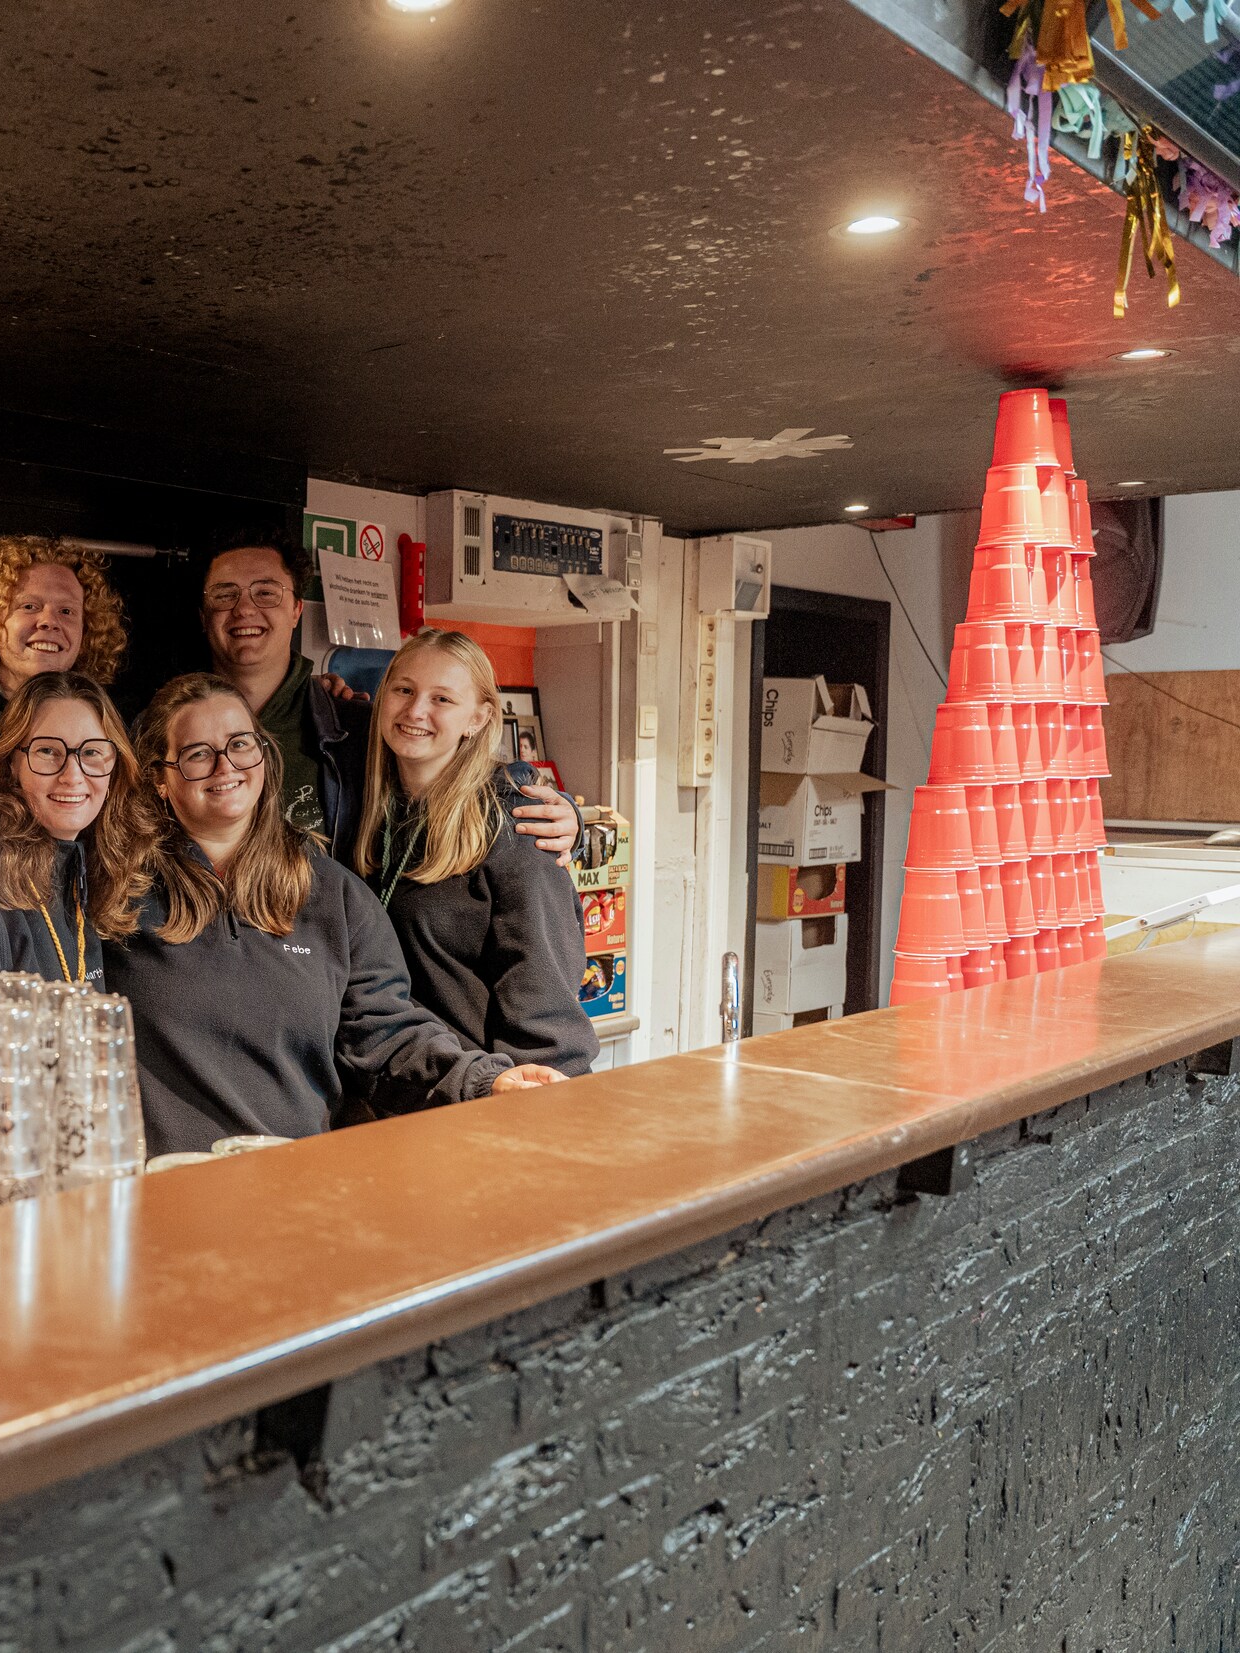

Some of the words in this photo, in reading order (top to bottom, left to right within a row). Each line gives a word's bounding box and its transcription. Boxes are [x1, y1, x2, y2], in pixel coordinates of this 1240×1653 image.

[762, 689, 779, 728] Chips
[814, 804, 833, 818] Chips
[578, 871, 600, 887] MAX
[283, 944, 311, 955] Febe
